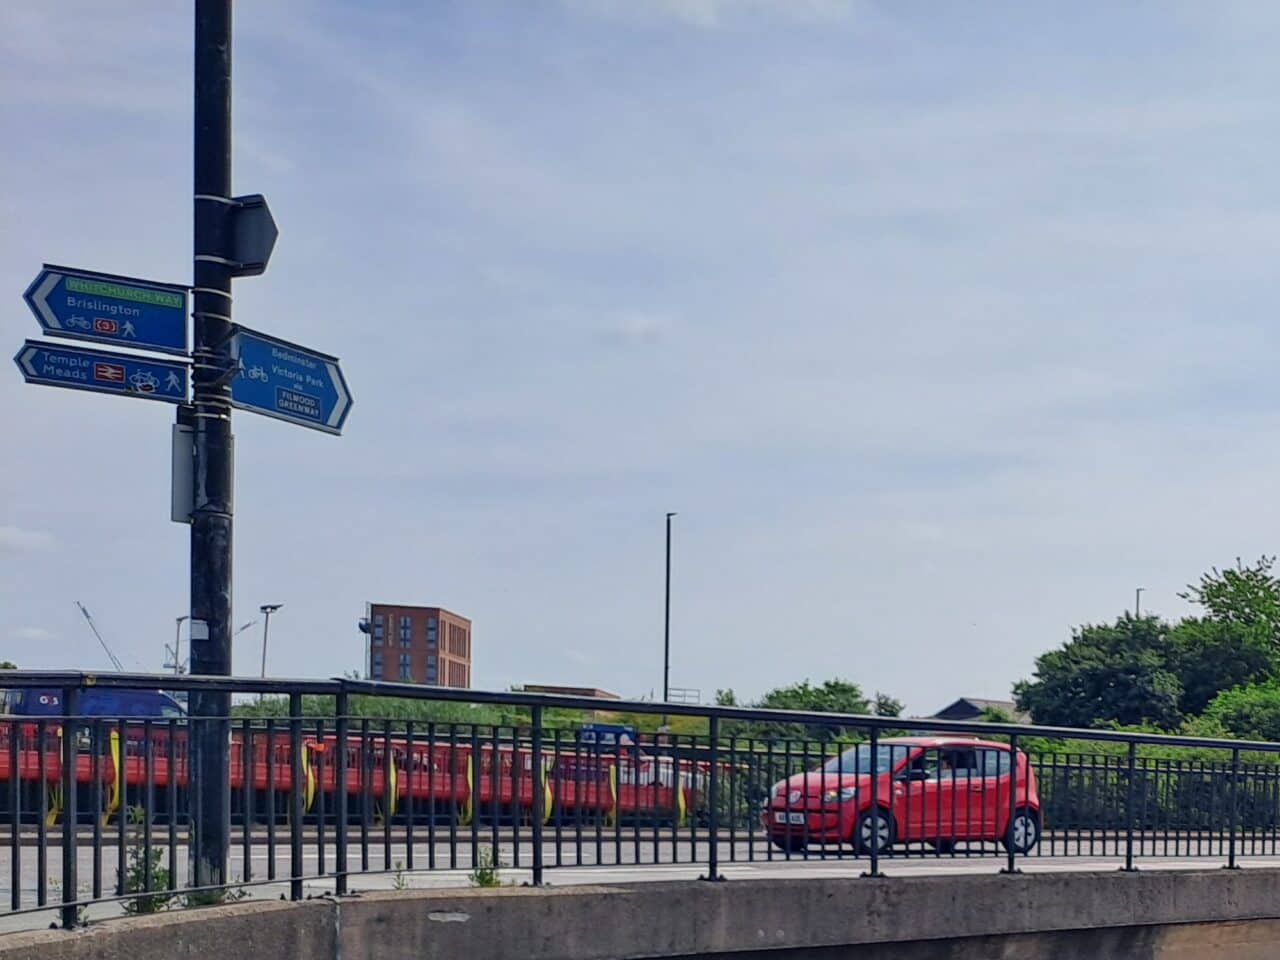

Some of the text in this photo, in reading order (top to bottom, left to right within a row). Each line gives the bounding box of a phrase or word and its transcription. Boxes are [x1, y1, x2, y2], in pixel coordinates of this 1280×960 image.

[67, 280, 181, 306] WHITCHURCH WAY
[66, 296, 140, 317] Brislington
[41, 351, 90, 367] Temple
[42, 364, 88, 380] Meads
[271, 364, 324, 388] Victoria Park
[278, 399, 320, 417] GREENWAY
[282, 391, 316, 407] FILWOOD
